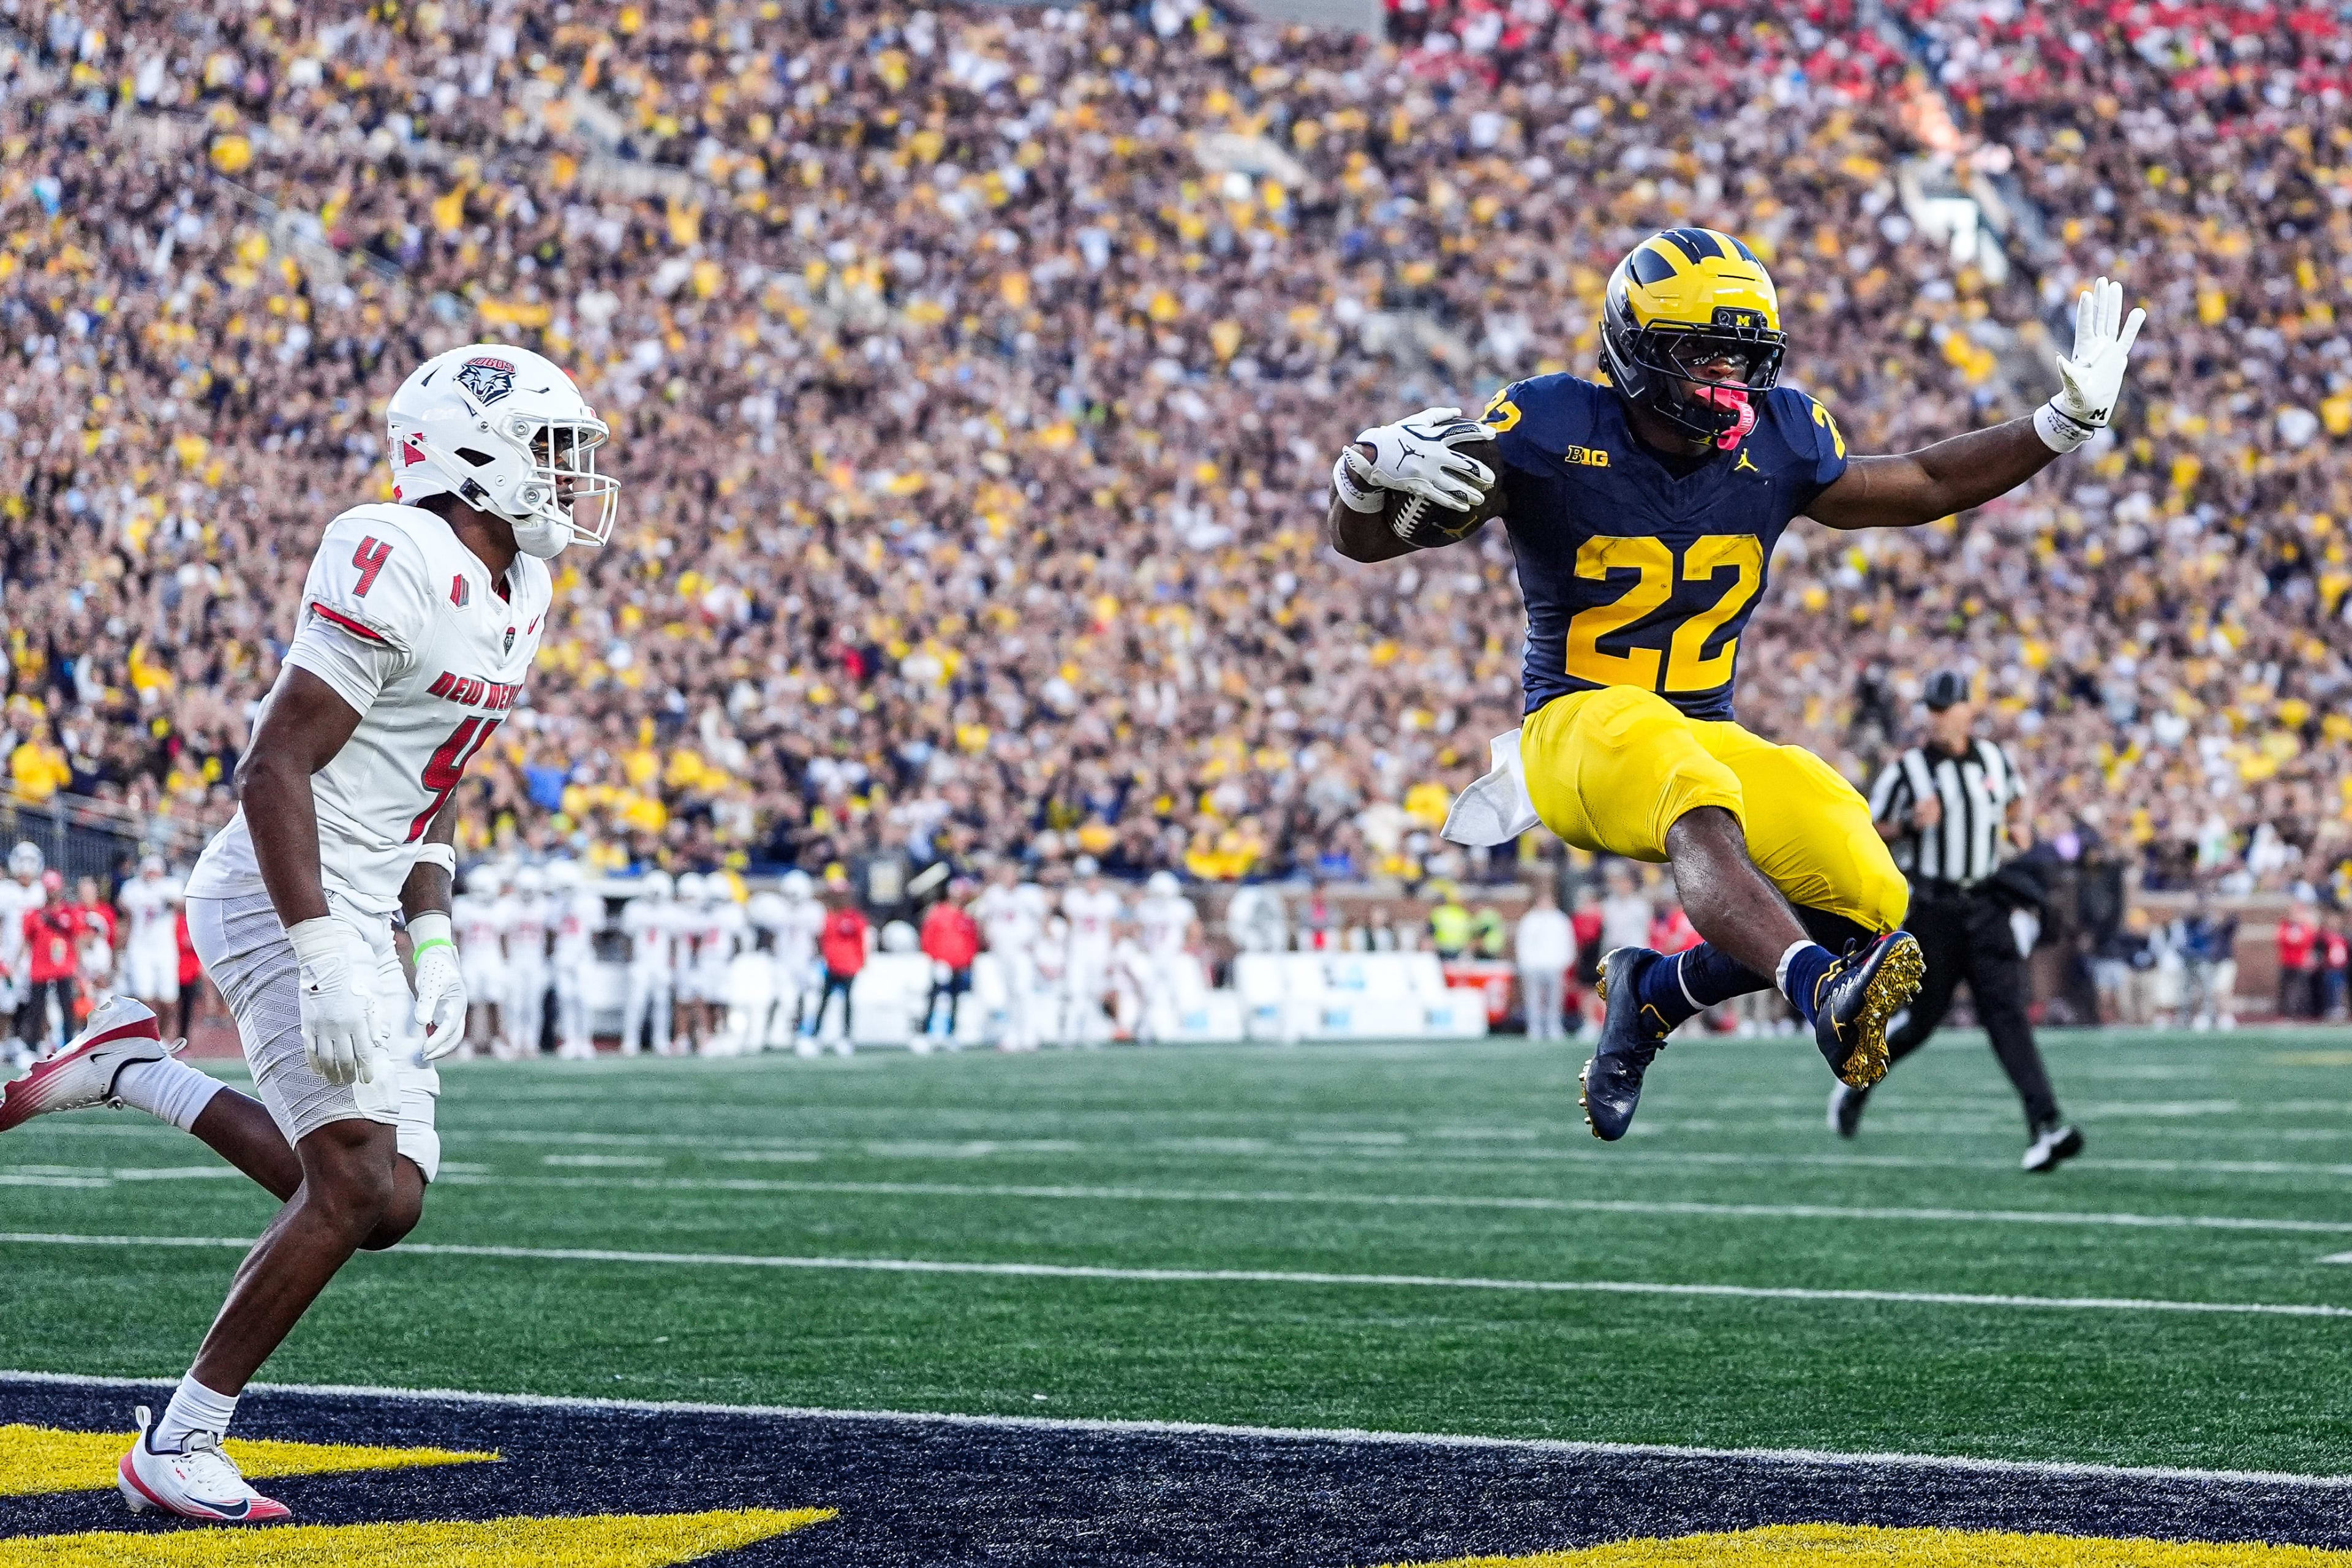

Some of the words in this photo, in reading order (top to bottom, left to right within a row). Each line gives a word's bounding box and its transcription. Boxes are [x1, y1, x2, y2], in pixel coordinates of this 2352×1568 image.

[1736, 314, 1751, 327] M
[464, 357, 515, 373] LOBOS
[2089, 407, 2108, 421] M
[352, 534, 394, 598] 4
[1565, 534, 1763, 692] 22
[425, 670, 485, 707] NEW
[404, 715, 505, 844] 4
